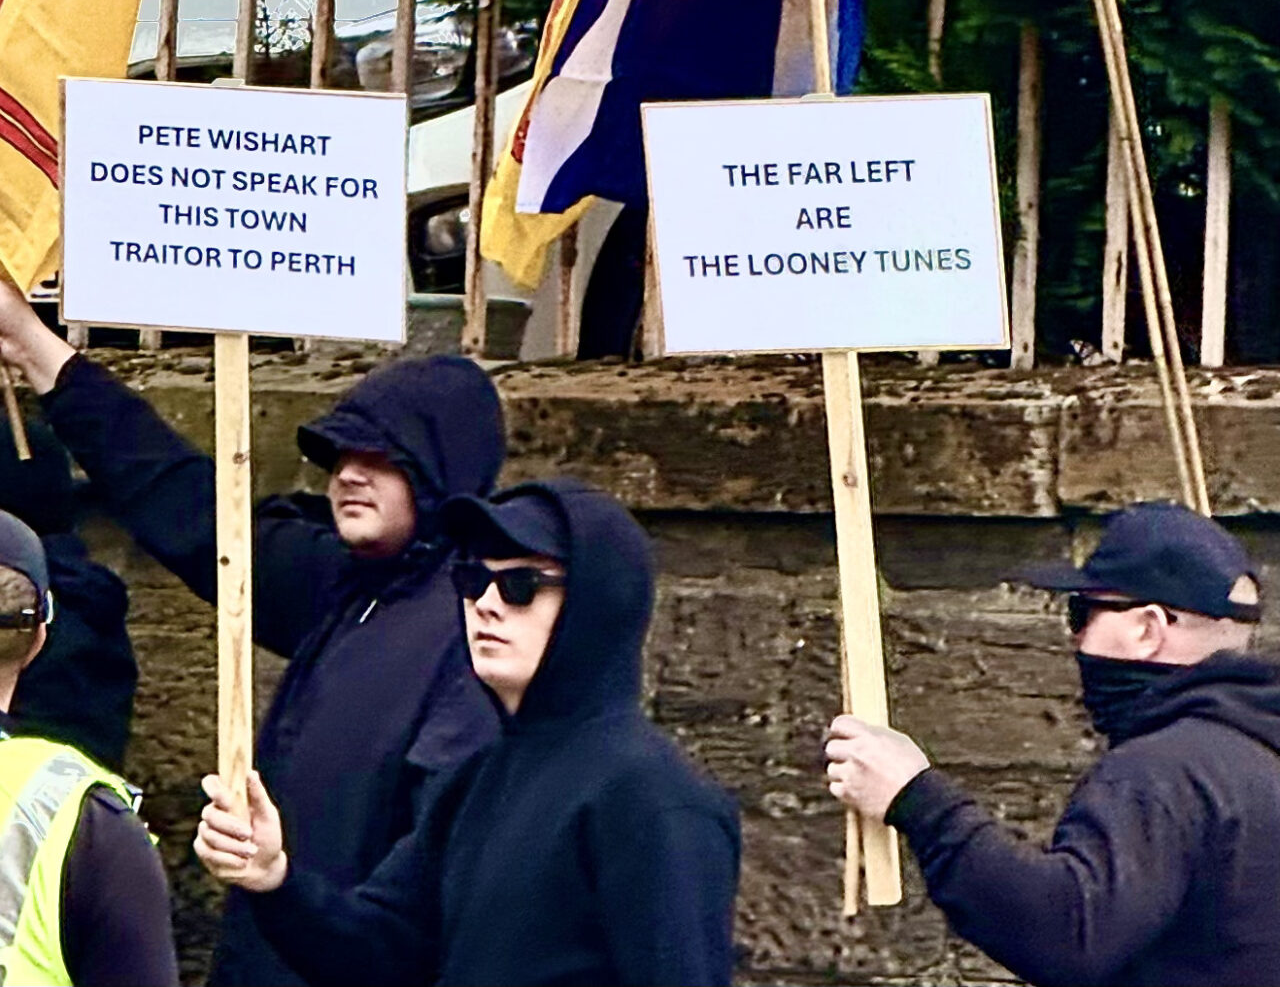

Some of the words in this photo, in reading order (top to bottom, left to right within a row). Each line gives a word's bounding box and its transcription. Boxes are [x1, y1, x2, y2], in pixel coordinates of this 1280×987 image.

[139, 125, 201, 147] PETE
[208, 129, 331, 156] WISHART
[91, 162, 163, 185] DOES
[172, 168, 225, 189] NOT
[232, 171, 317, 196] SPEAK
[326, 177, 378, 198] FOR
[722, 164, 779, 187] THE
[789, 162, 843, 185] FAR
[851, 160, 916, 183] LEFT
[159, 204, 218, 227] THIS
[225, 209, 307, 232] TOWN
[796, 206, 852, 229] ARE
[110, 241, 221, 267] TRAITOR
[229, 249, 262, 269] TO
[271, 252, 355, 276] PERTH
[683, 255, 740, 277] THE
[748, 251, 867, 276] LOONEY
[874, 248, 971, 272] TUNES
